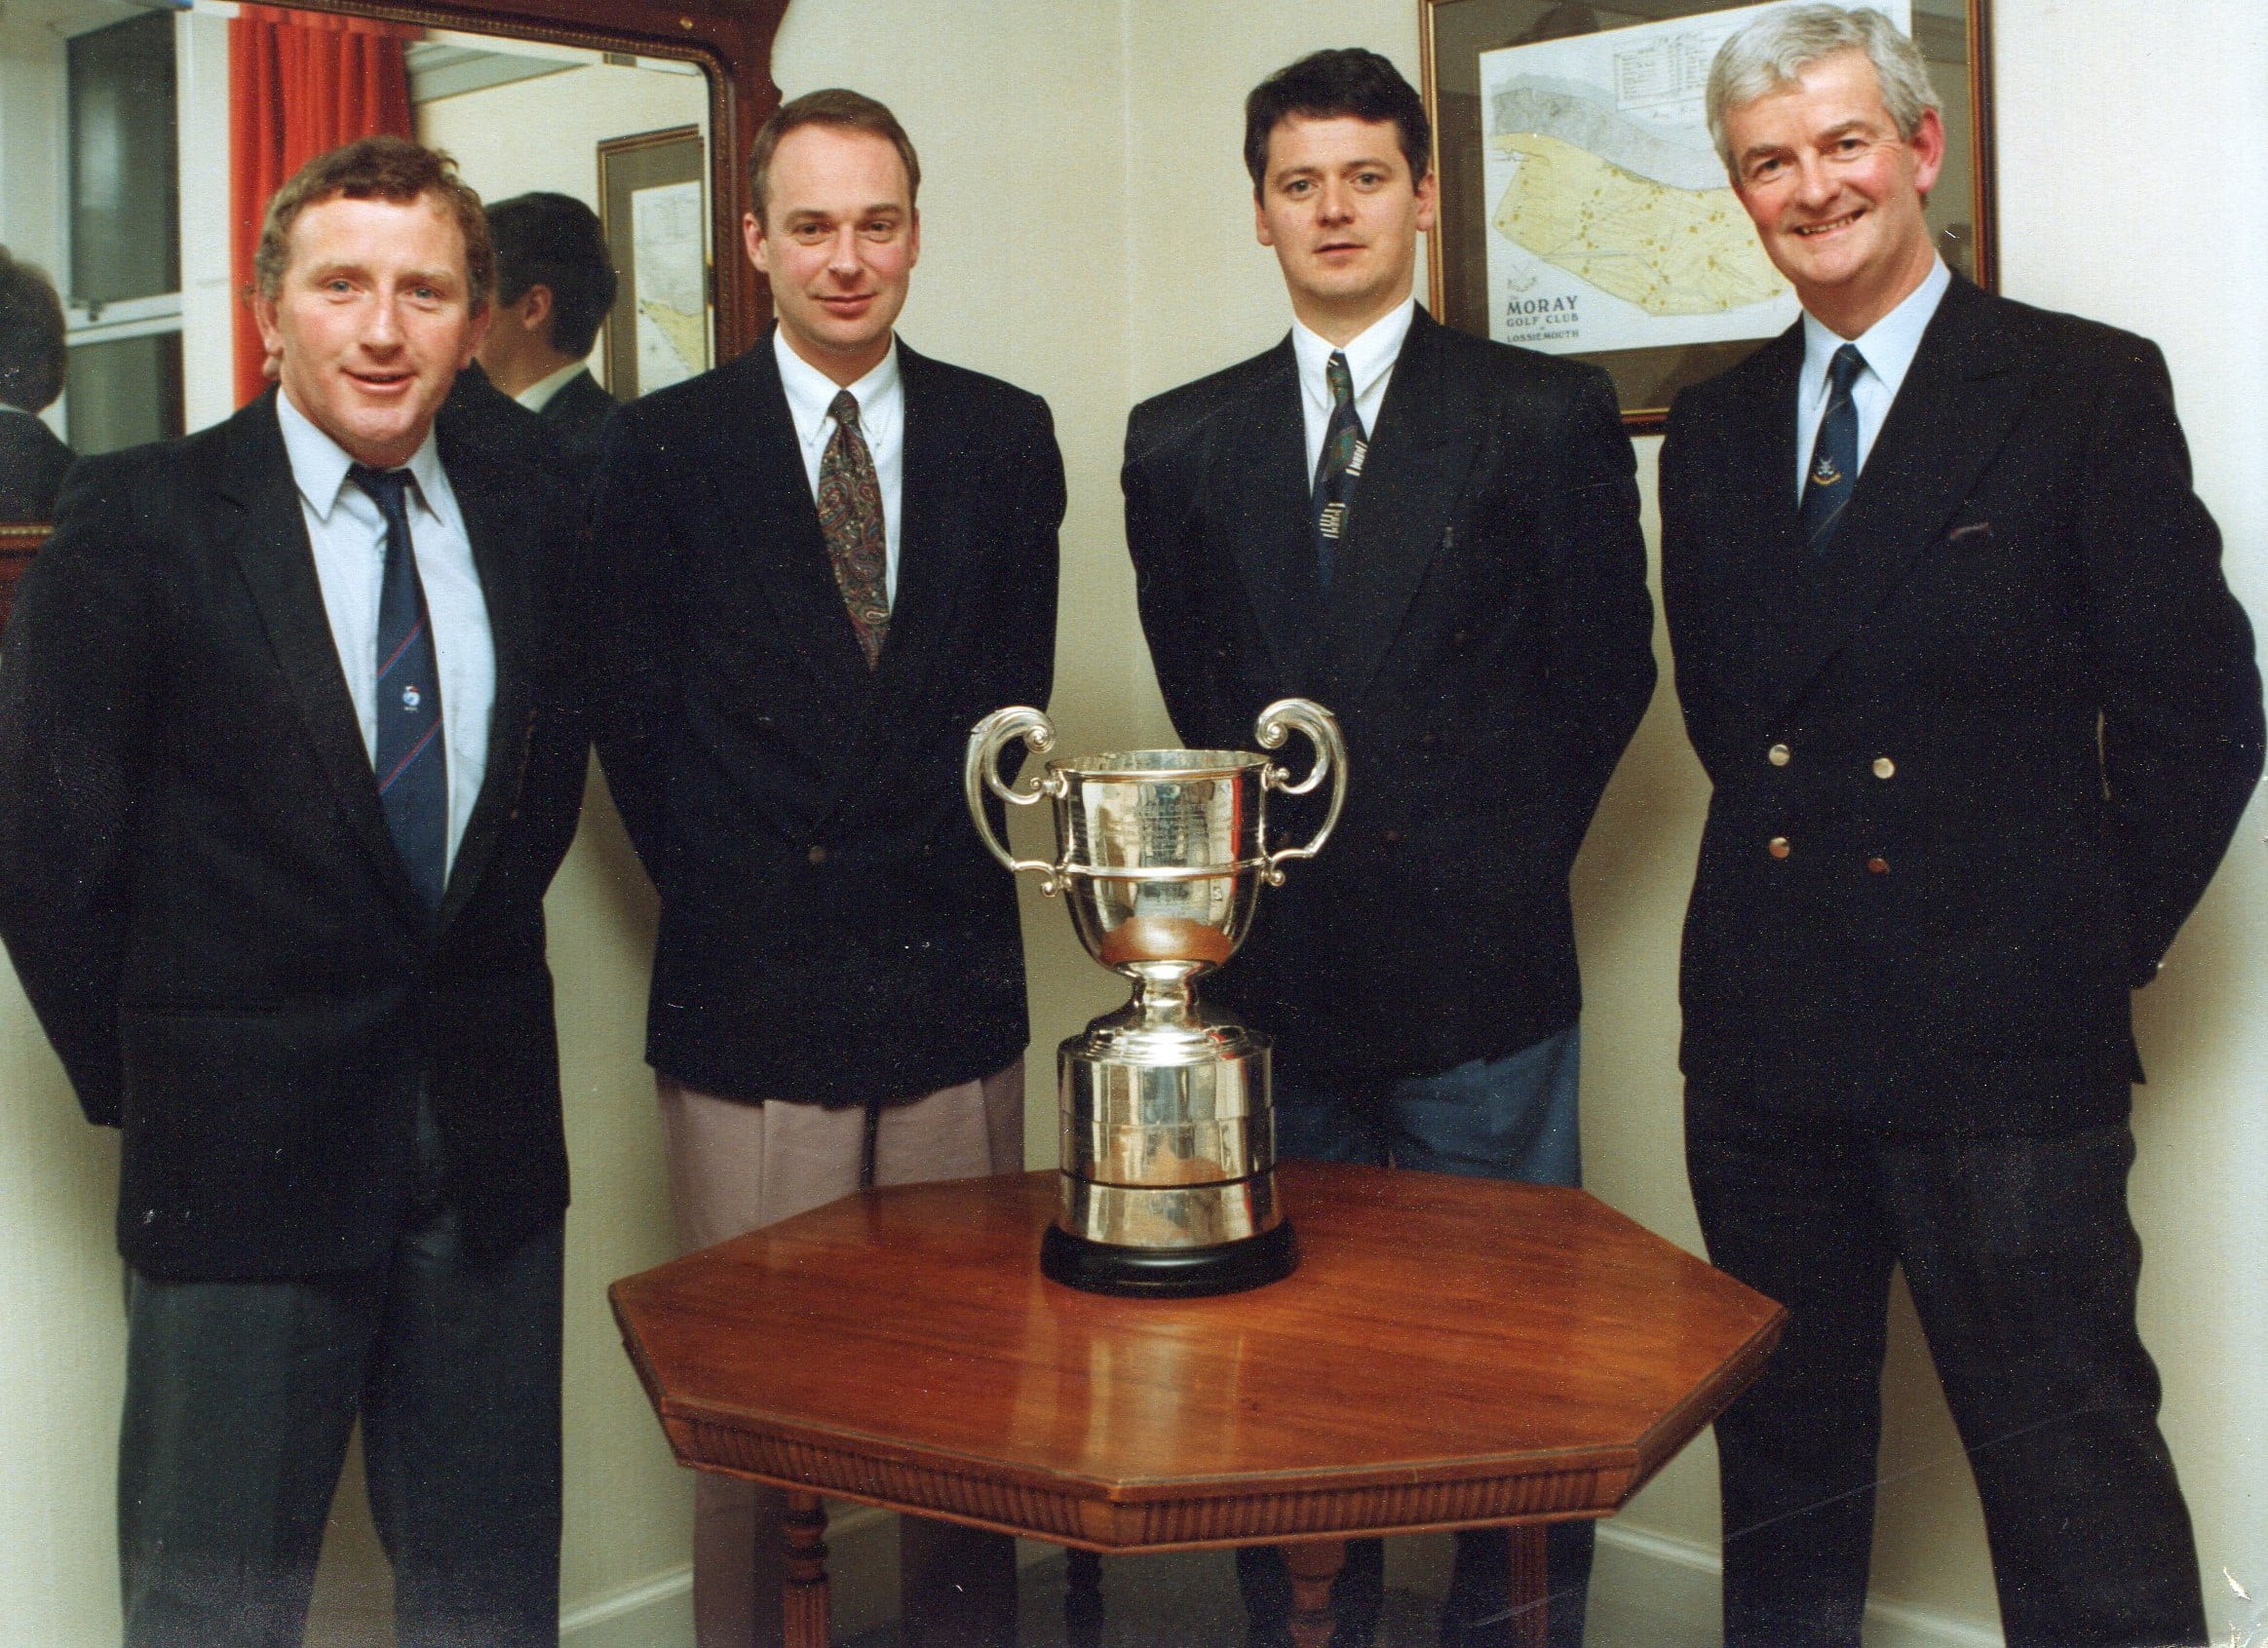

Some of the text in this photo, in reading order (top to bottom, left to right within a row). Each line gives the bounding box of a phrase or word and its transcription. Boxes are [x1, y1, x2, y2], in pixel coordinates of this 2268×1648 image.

[1506, 295, 1578, 316] MORAY
[1507, 312, 1579, 327] GOLF CLUB
[1507, 330, 1579, 343] LOSSIEMOUTH
